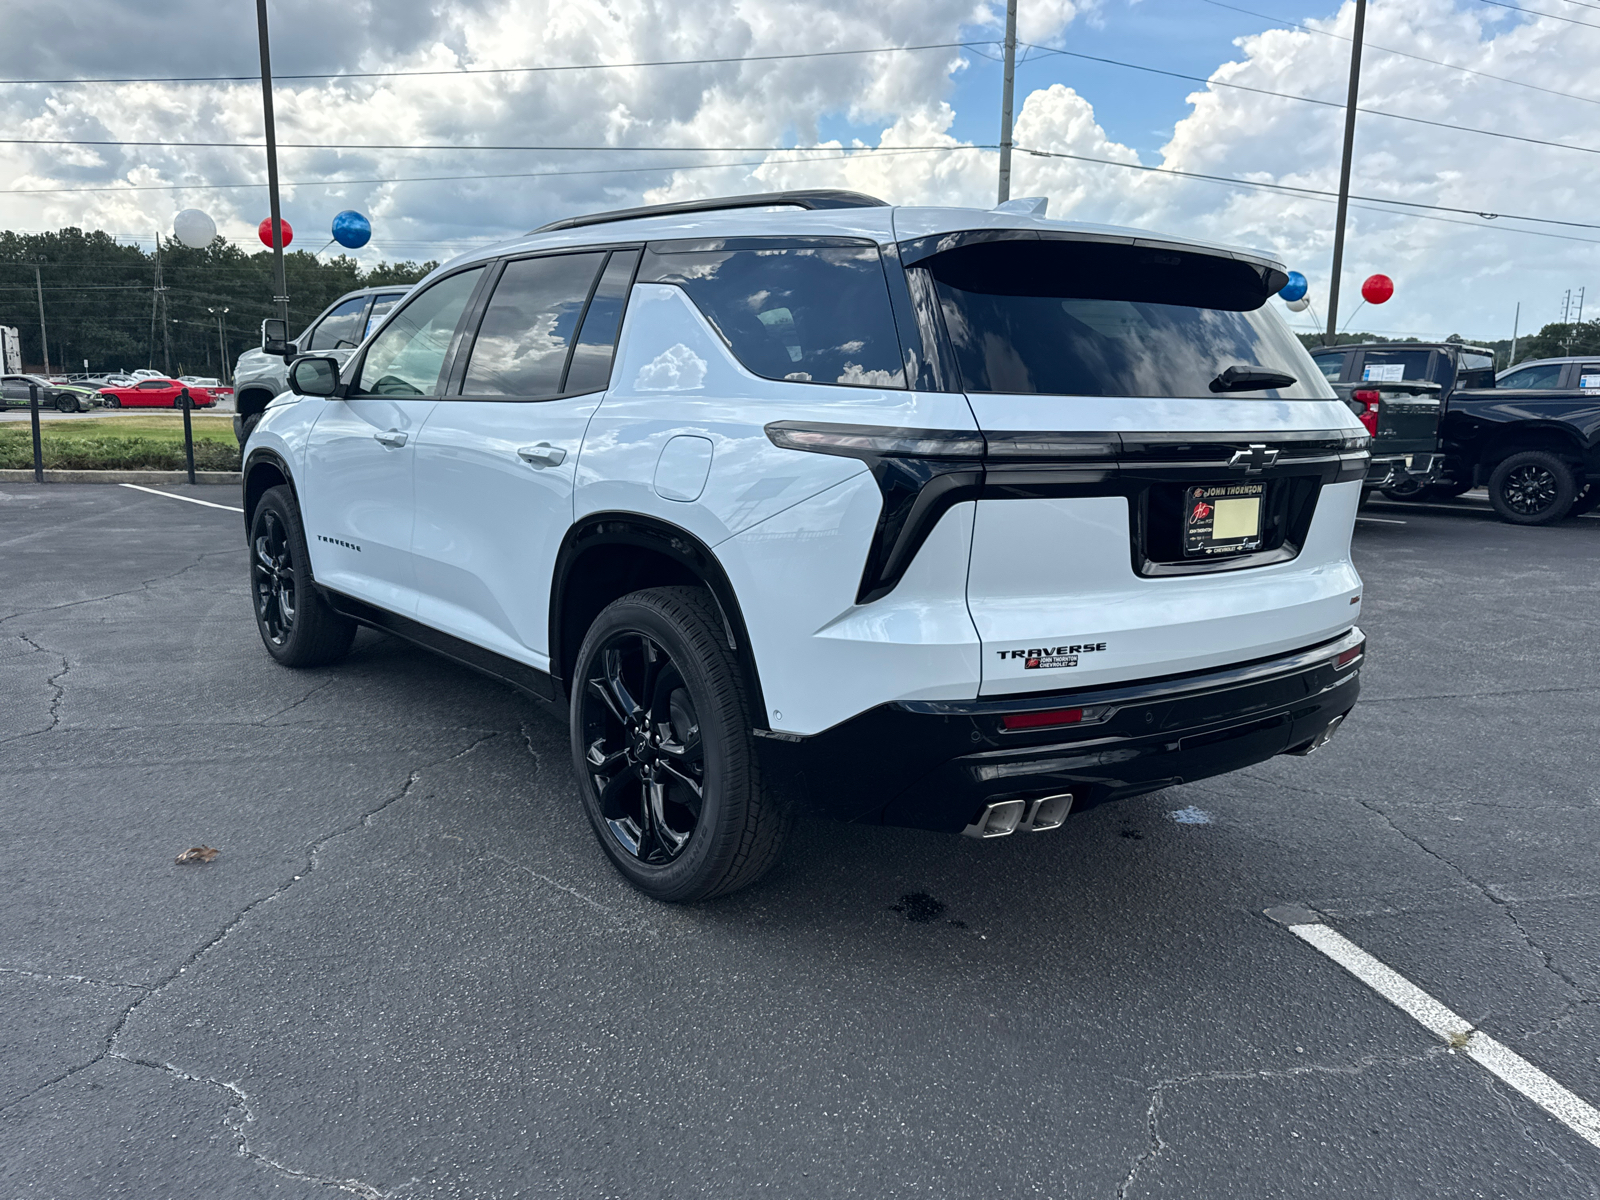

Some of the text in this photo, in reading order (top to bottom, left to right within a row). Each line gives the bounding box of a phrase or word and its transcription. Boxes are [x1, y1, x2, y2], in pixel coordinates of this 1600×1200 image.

[1206, 485, 1263, 497] JOHN THORNTON
[316, 534, 362, 553] TRAVERSE
[996, 642, 1107, 660] TRAVERSE
